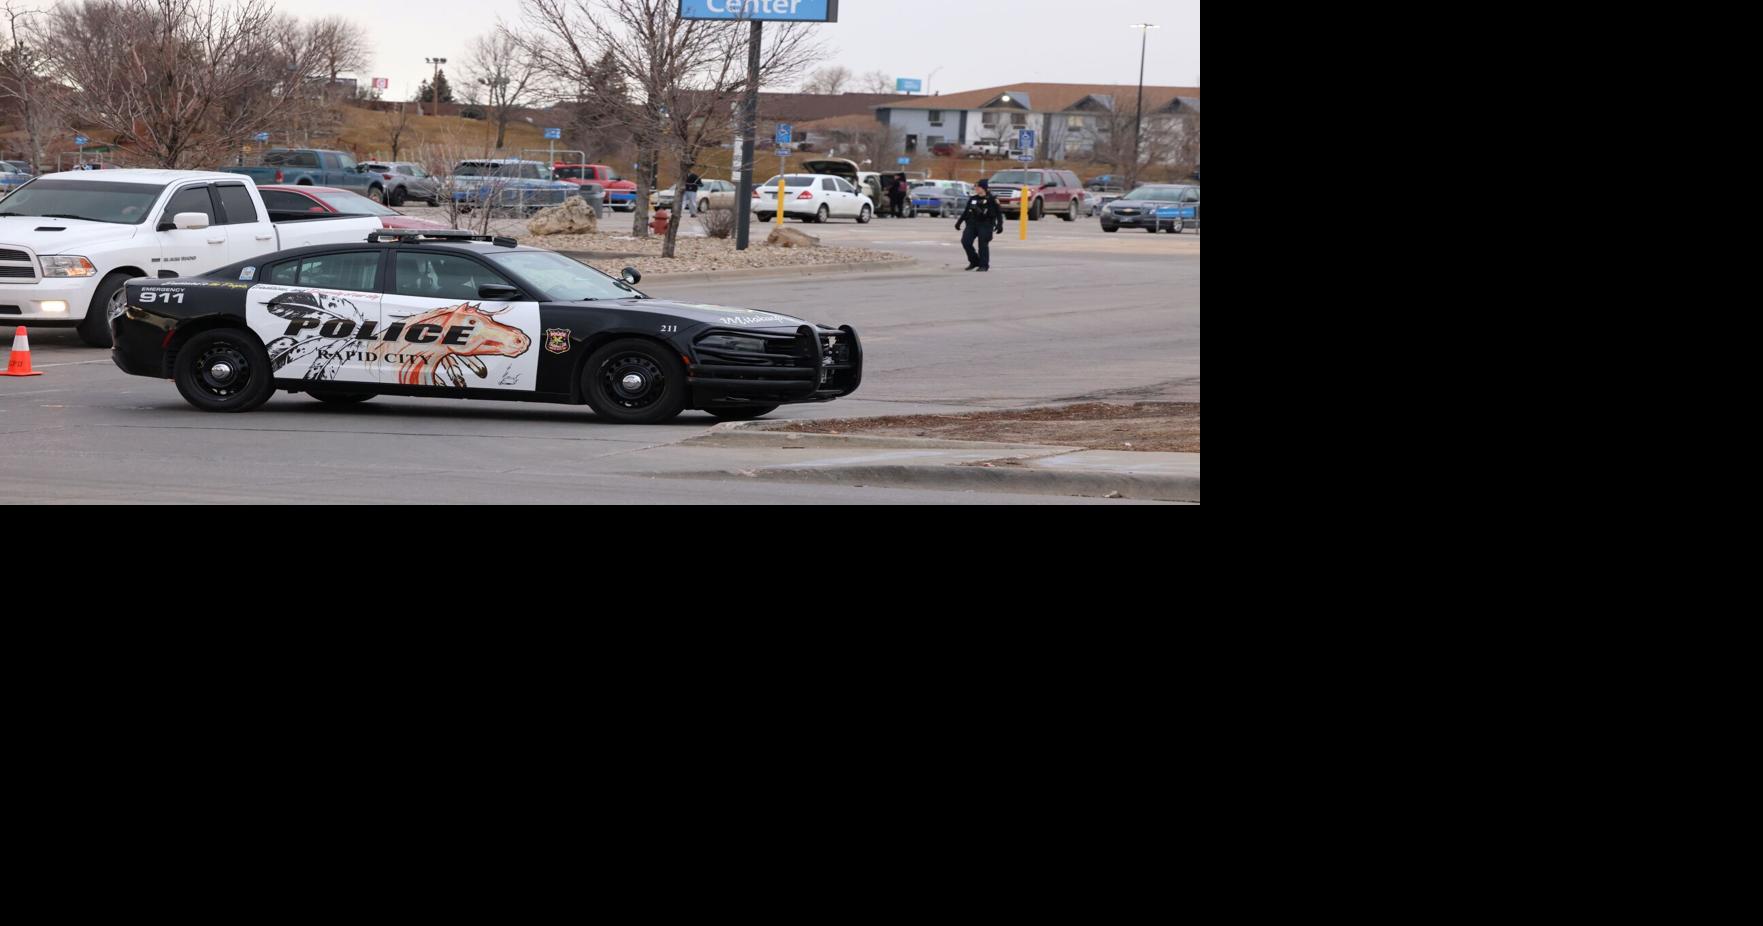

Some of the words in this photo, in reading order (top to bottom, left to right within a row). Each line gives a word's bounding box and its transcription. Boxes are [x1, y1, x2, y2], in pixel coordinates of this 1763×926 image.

[706, 0, 800, 14] Center
[139, 291, 185, 304] 911
[284, 318, 475, 345] POLICE
[660, 324, 678, 333] 211
[318, 350, 379, 362] RAPID
[384, 351, 433, 365] CITY
